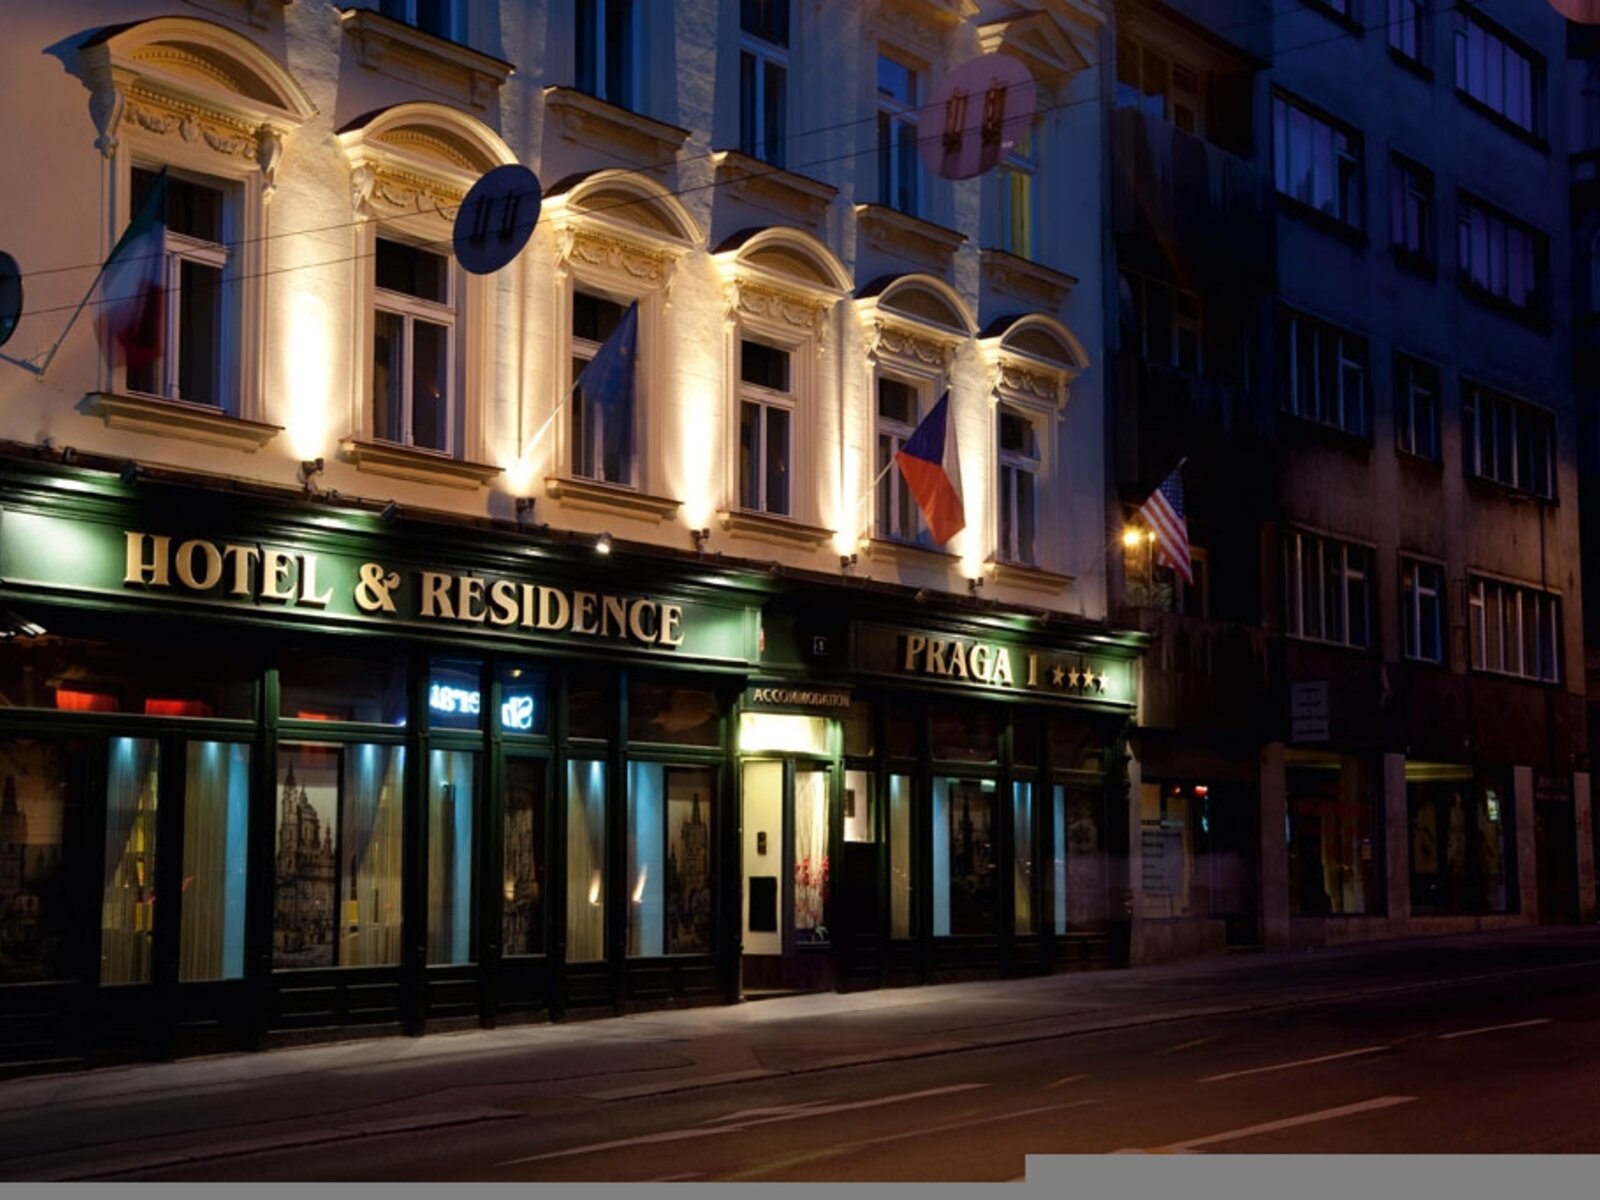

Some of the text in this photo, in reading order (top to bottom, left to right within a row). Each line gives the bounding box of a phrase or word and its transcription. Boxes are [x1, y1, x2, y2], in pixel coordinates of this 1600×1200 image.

[125, 531, 684, 647] HOTEL & RESIDENCE
[905, 635, 1013, 686] PRAGA
[753, 688, 851, 707] ACCOMMODATION
